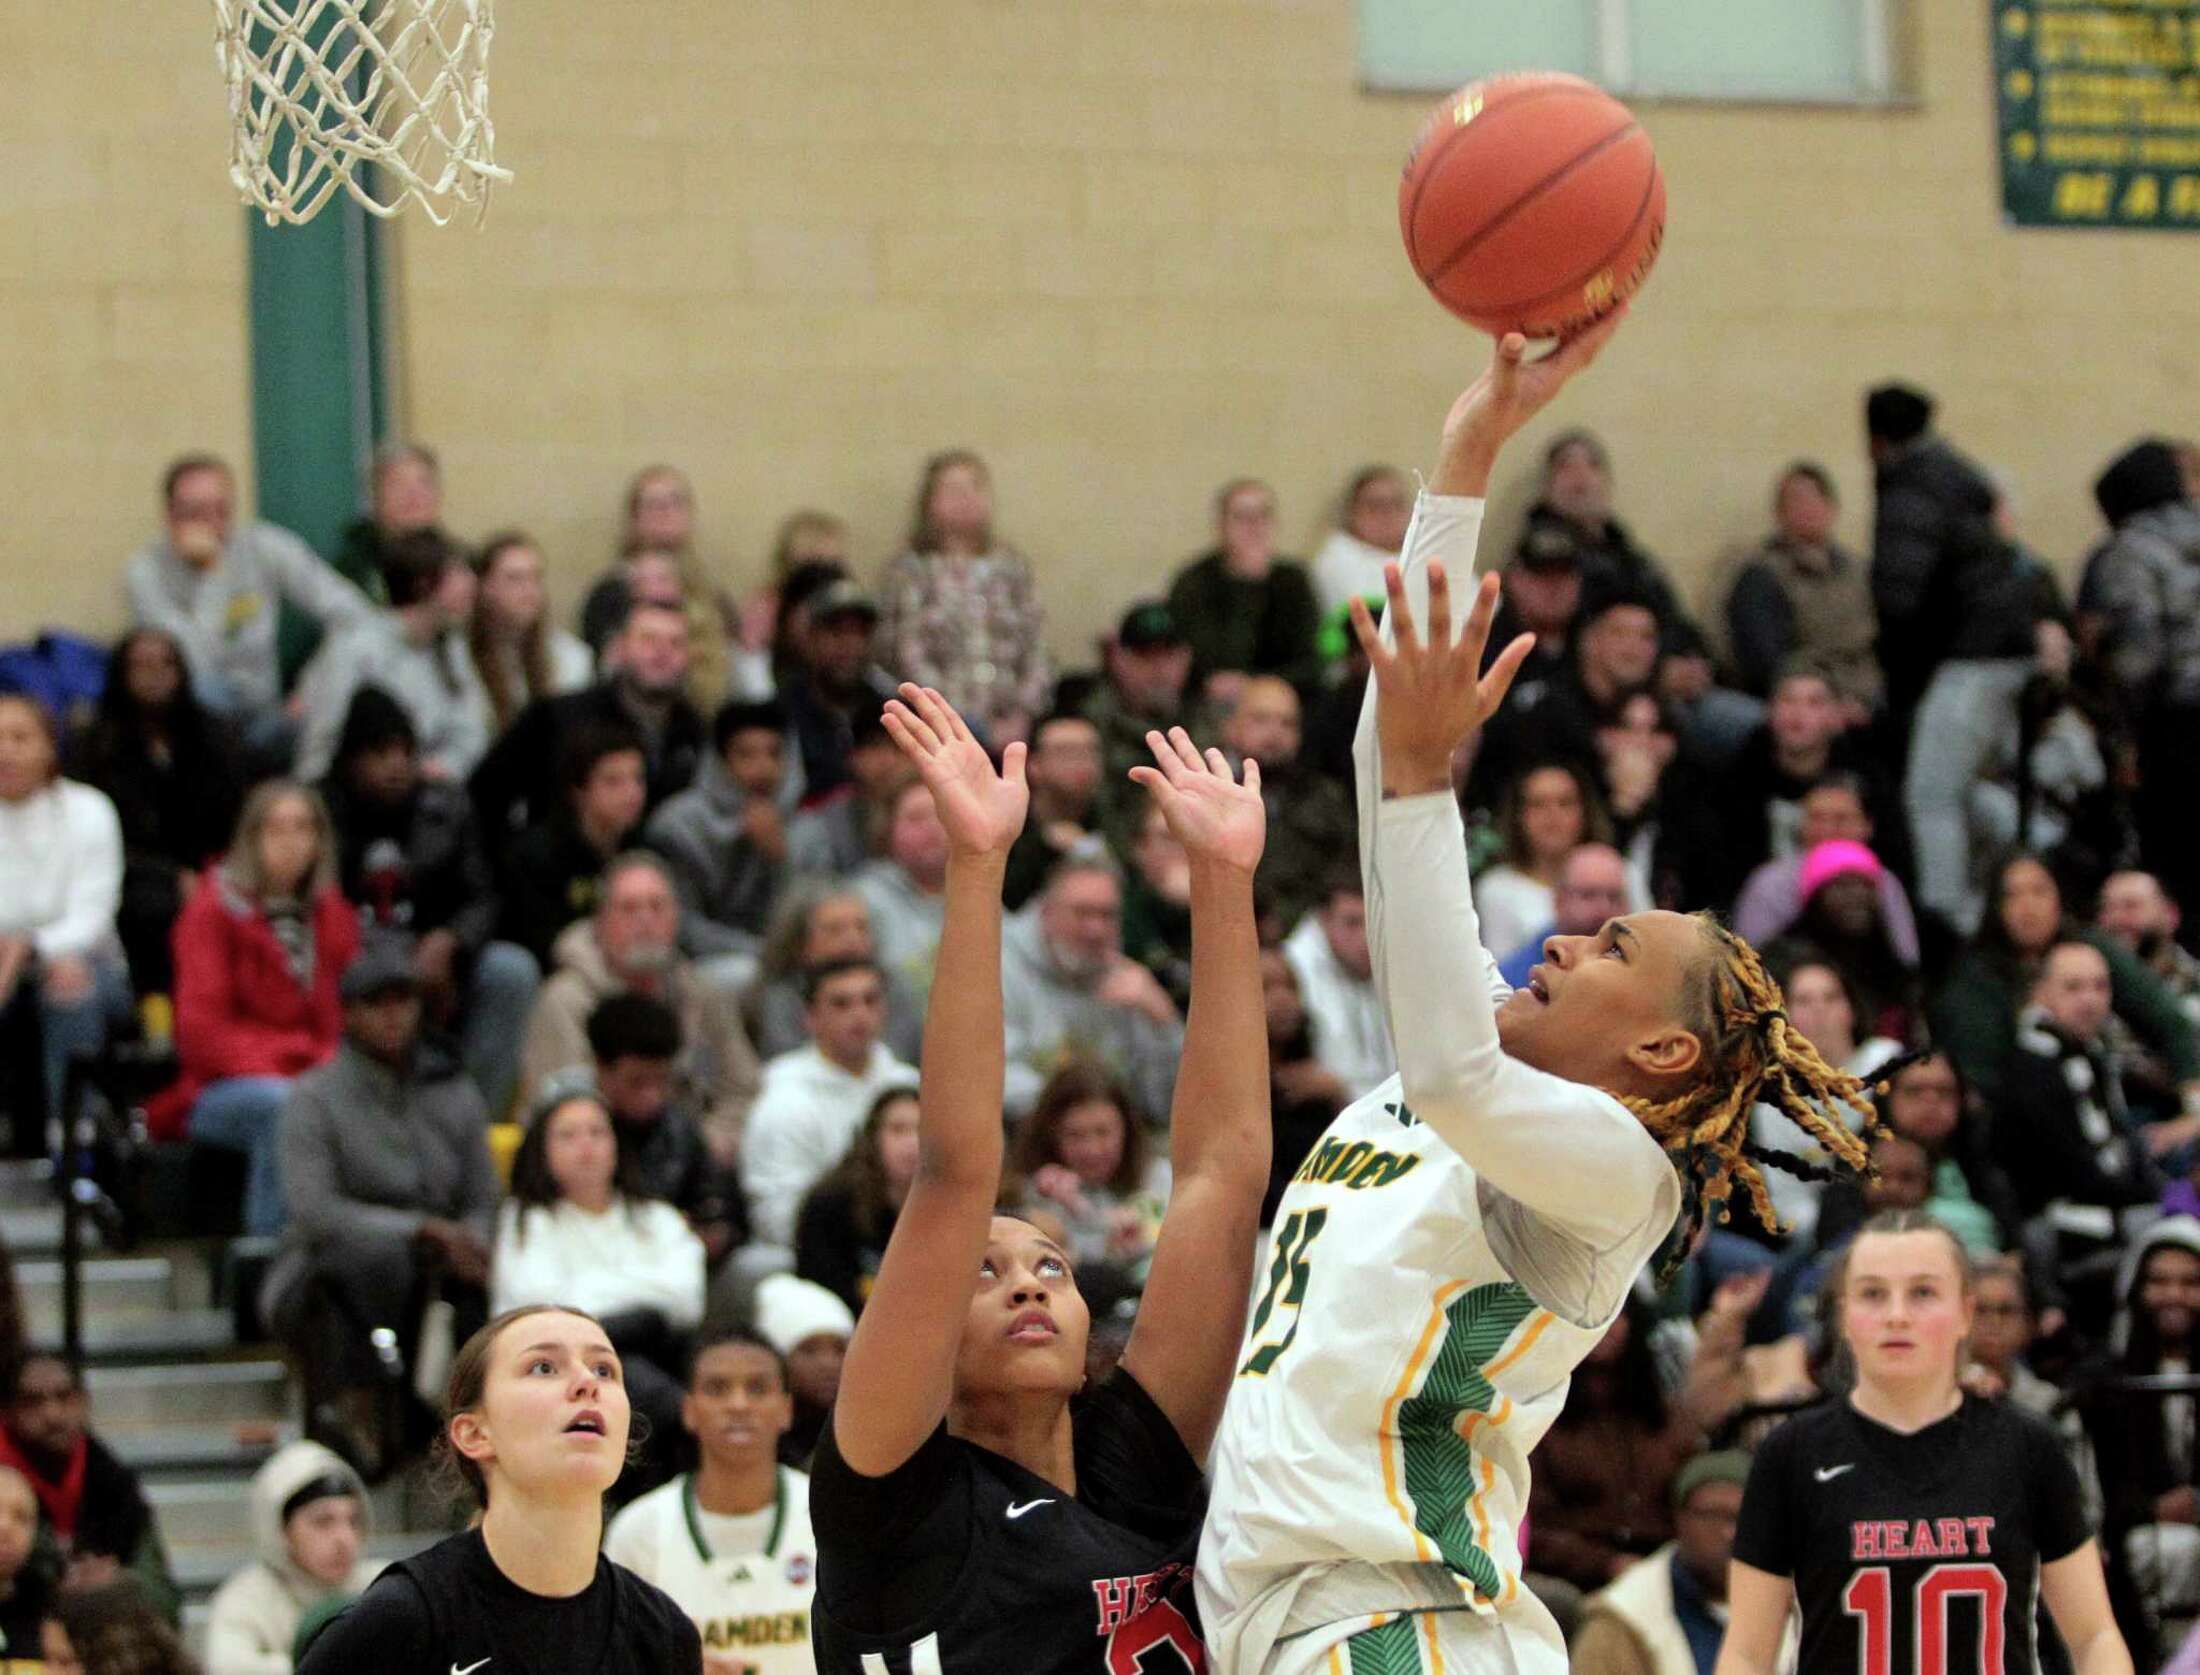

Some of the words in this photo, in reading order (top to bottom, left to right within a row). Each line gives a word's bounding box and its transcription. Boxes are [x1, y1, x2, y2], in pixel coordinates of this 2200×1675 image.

[1237, 1206, 1328, 1377] 15
[1853, 1516, 1995, 1559] HEART
[703, 1612, 807, 1649] AMDEN
[1842, 1563, 2007, 1675] 10
